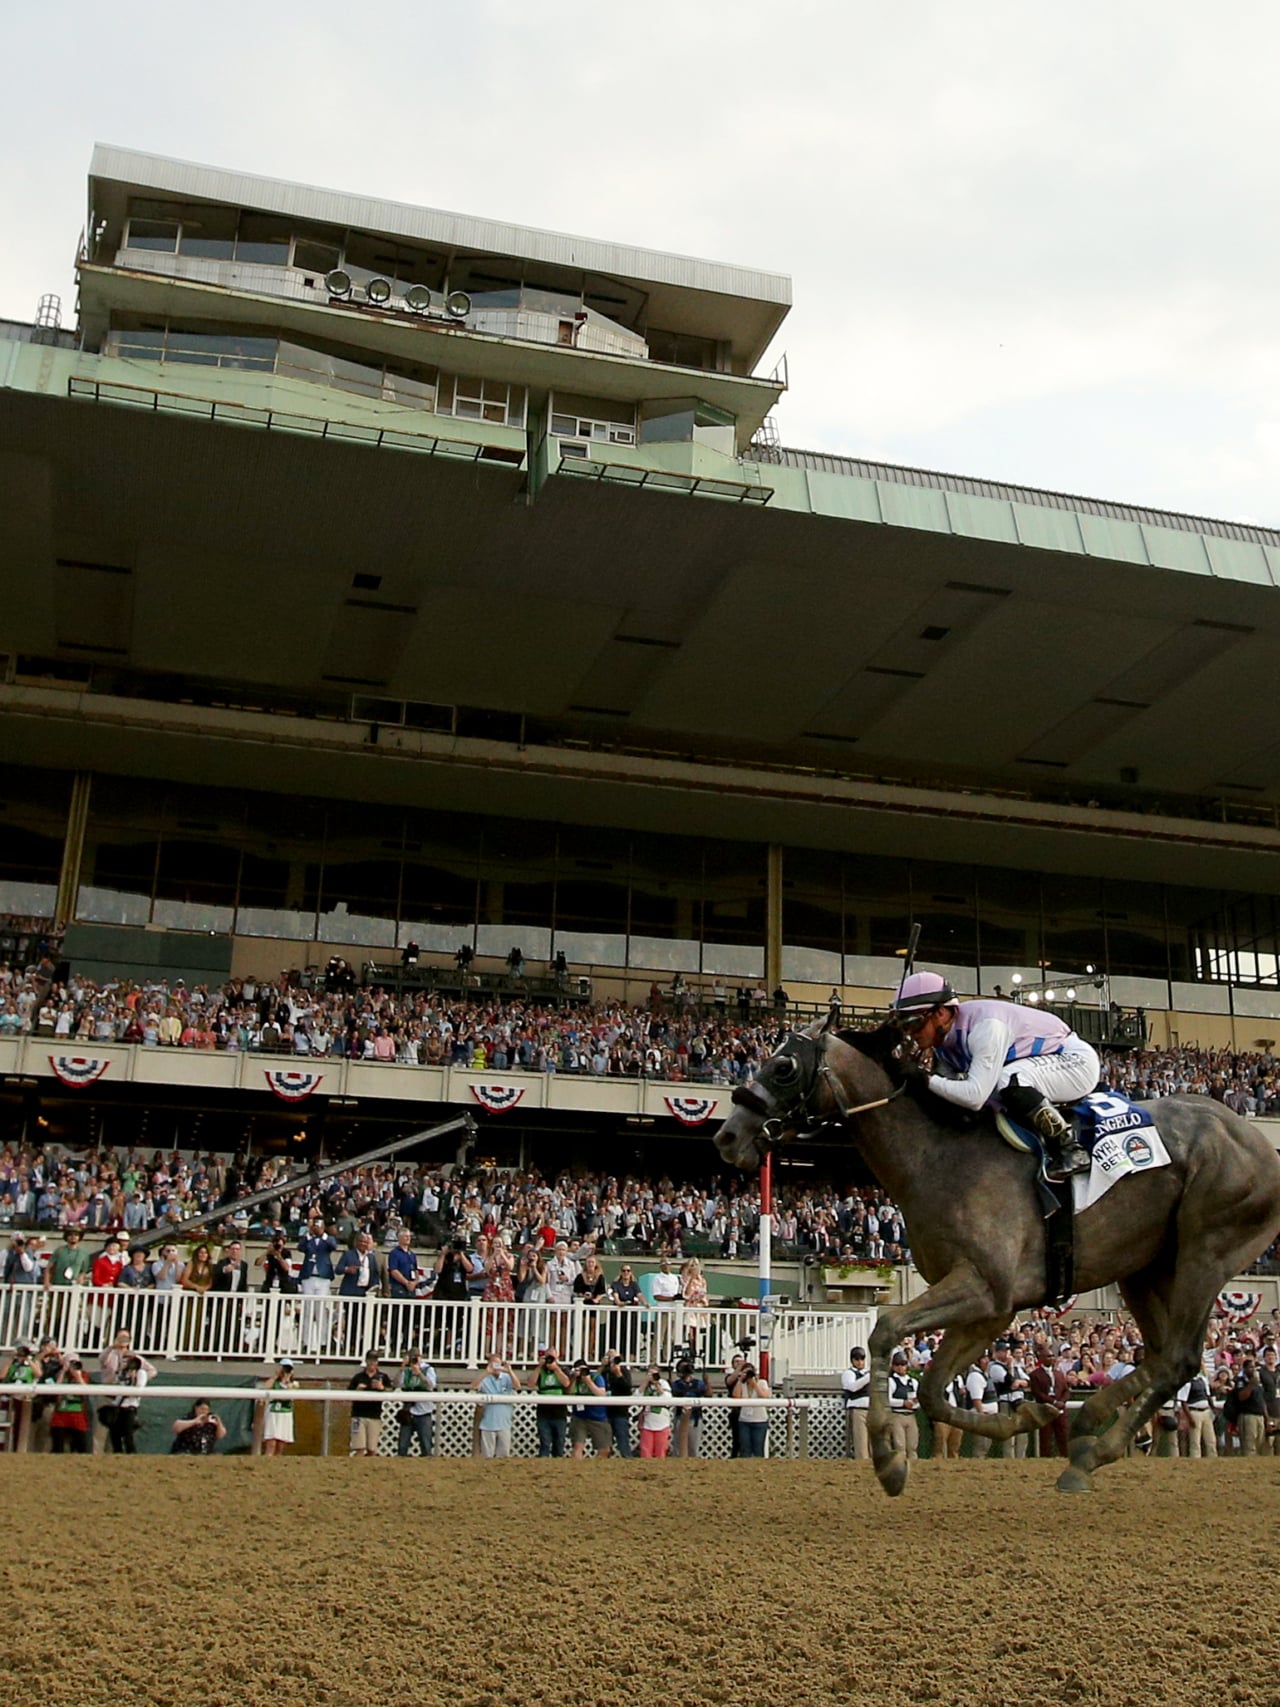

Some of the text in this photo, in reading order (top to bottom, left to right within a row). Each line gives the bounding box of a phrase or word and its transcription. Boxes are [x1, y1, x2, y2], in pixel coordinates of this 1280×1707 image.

[1095, 1112, 1142, 1138] NGELO
[1092, 1139, 1119, 1163] NYRA
[1101, 1151, 1128, 1172] BETS
